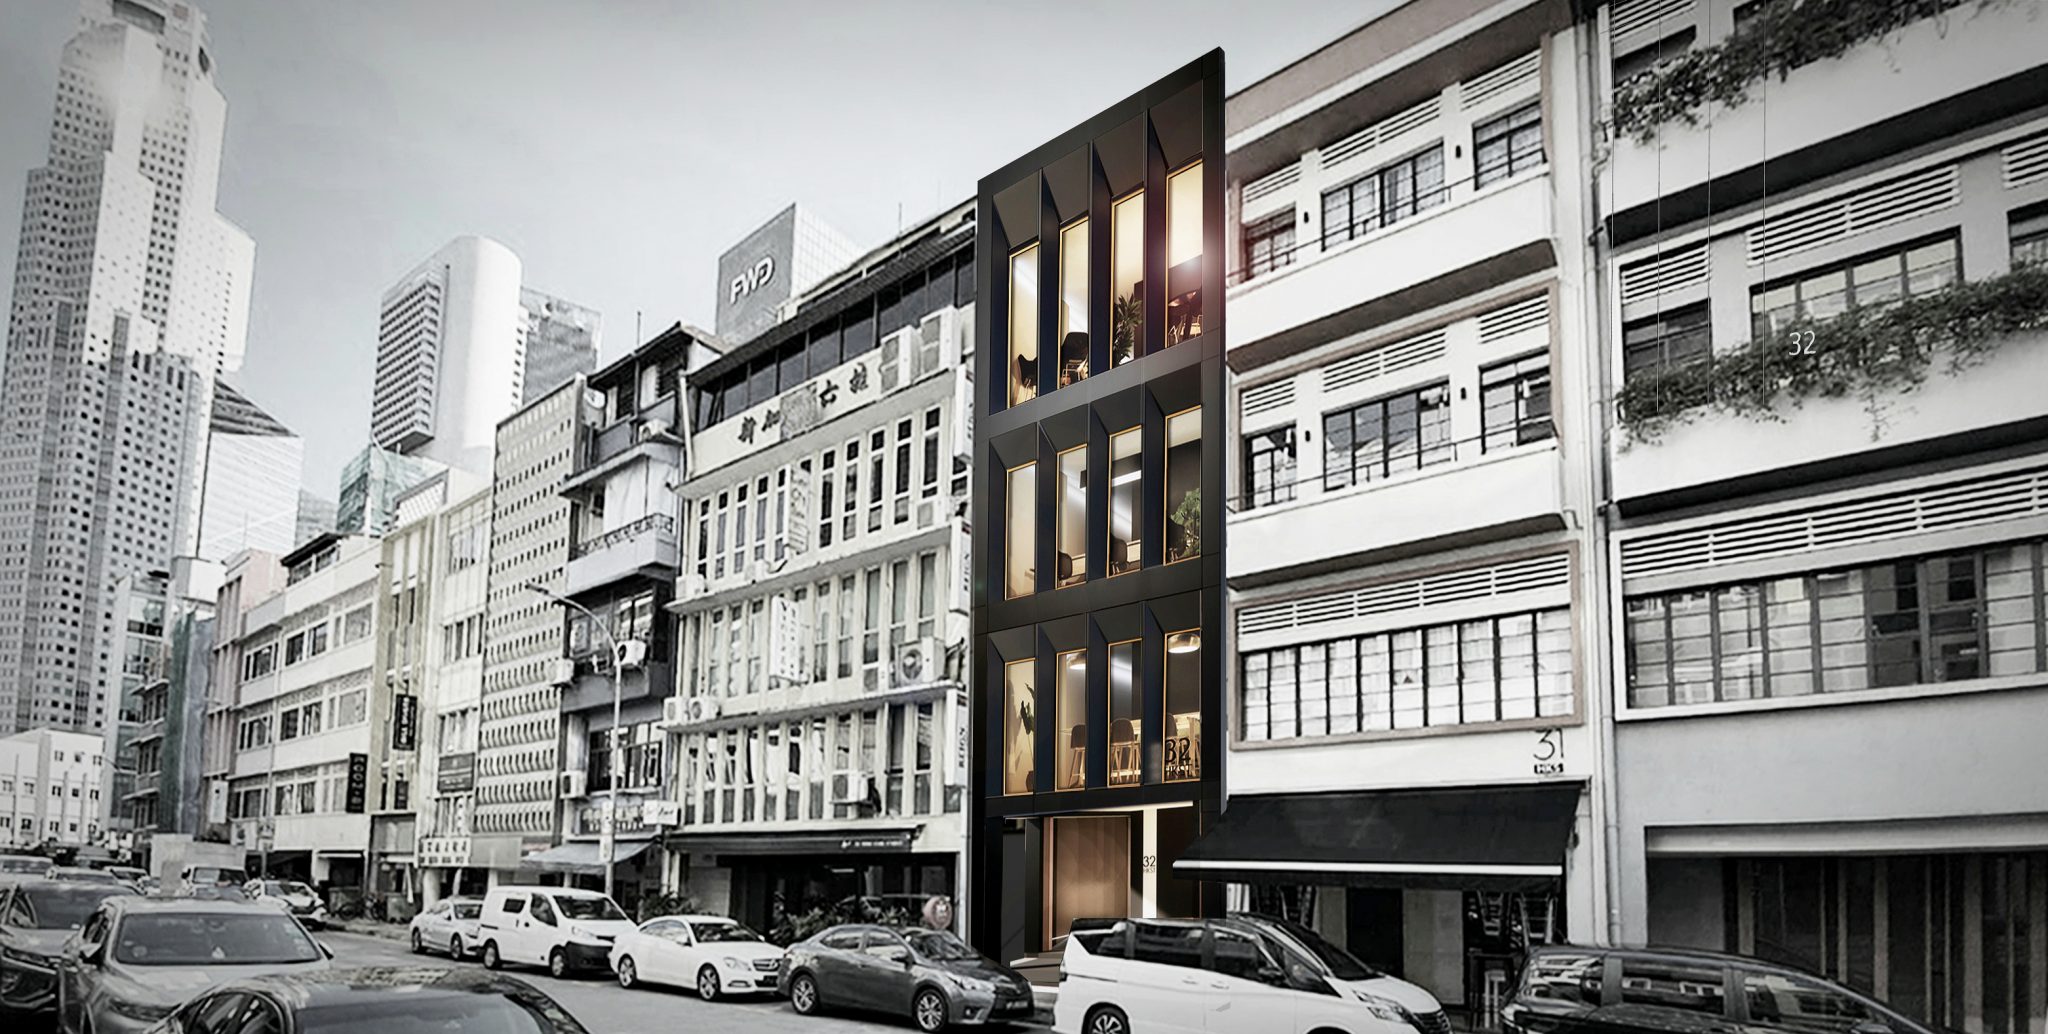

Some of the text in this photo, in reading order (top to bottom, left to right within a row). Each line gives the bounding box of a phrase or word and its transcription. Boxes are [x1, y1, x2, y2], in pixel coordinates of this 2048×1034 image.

[730, 257, 774, 304] FWD
[1788, 330, 1816, 355] 32
[1165, 738, 1191, 762] 32
[1533, 727, 1564, 761] 31
[1142, 855, 1156, 868] 32
